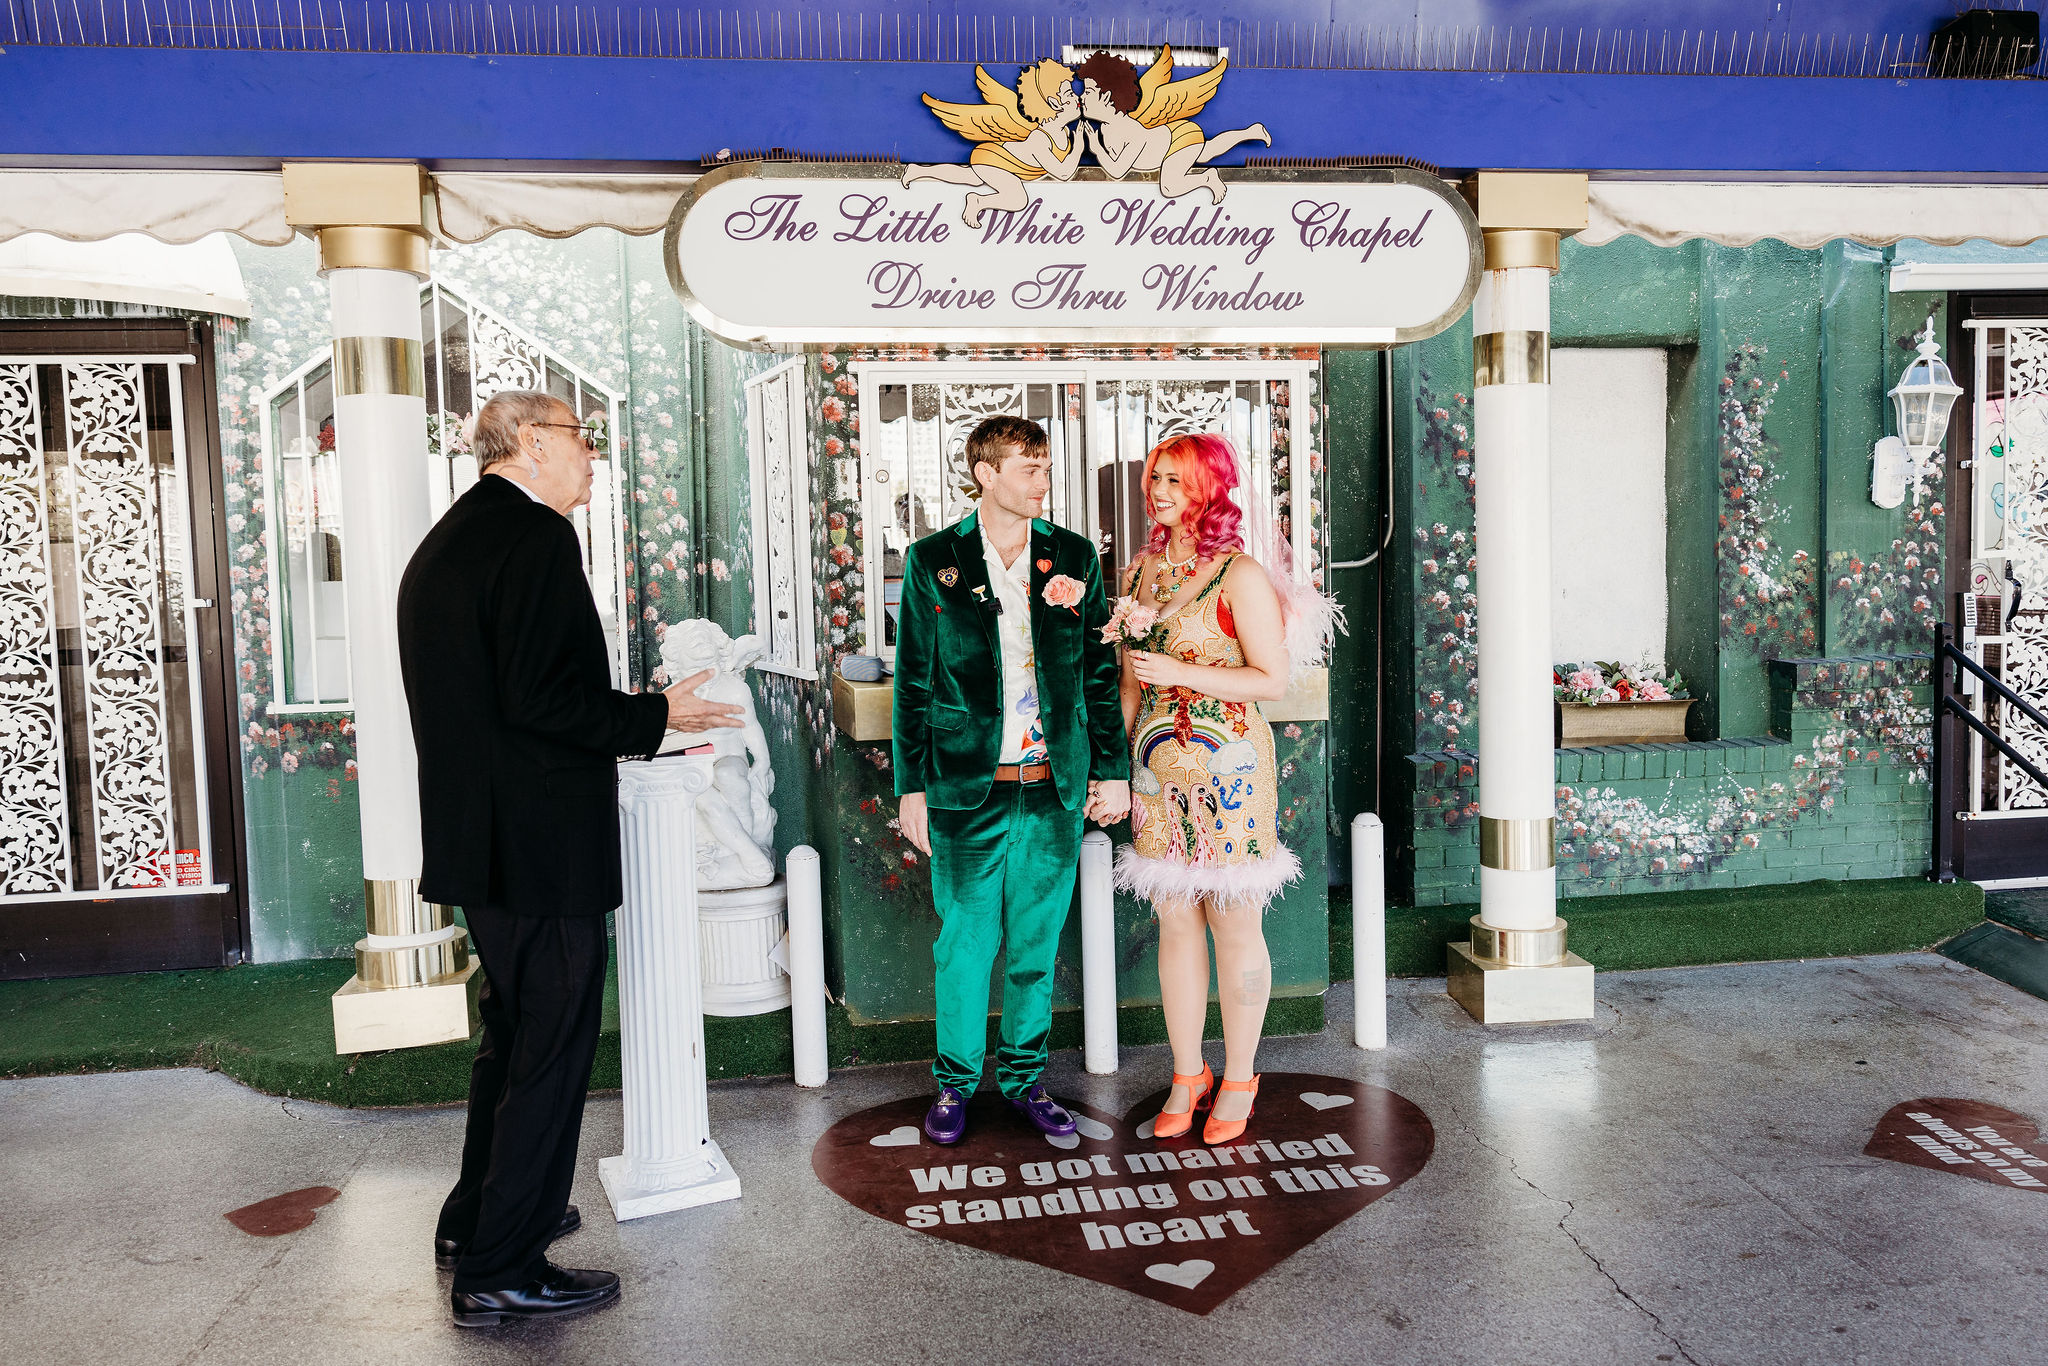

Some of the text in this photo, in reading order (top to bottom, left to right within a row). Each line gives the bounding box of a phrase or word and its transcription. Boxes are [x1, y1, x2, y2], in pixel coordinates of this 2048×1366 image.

[724, 194, 1425, 266] The Little White Wedding Chapel
[867, 260, 1305, 312] Drive Thru Window
[908, 1133, 1355, 1193] We got married
[1904, 1134, 1976, 1165] mind
[1905, 1112, 2048, 1187] always on my
[1964, 1125, 2048, 1168] You are
[904, 1160, 1392, 1229] standing on this
[1079, 1208, 1262, 1252] heart
